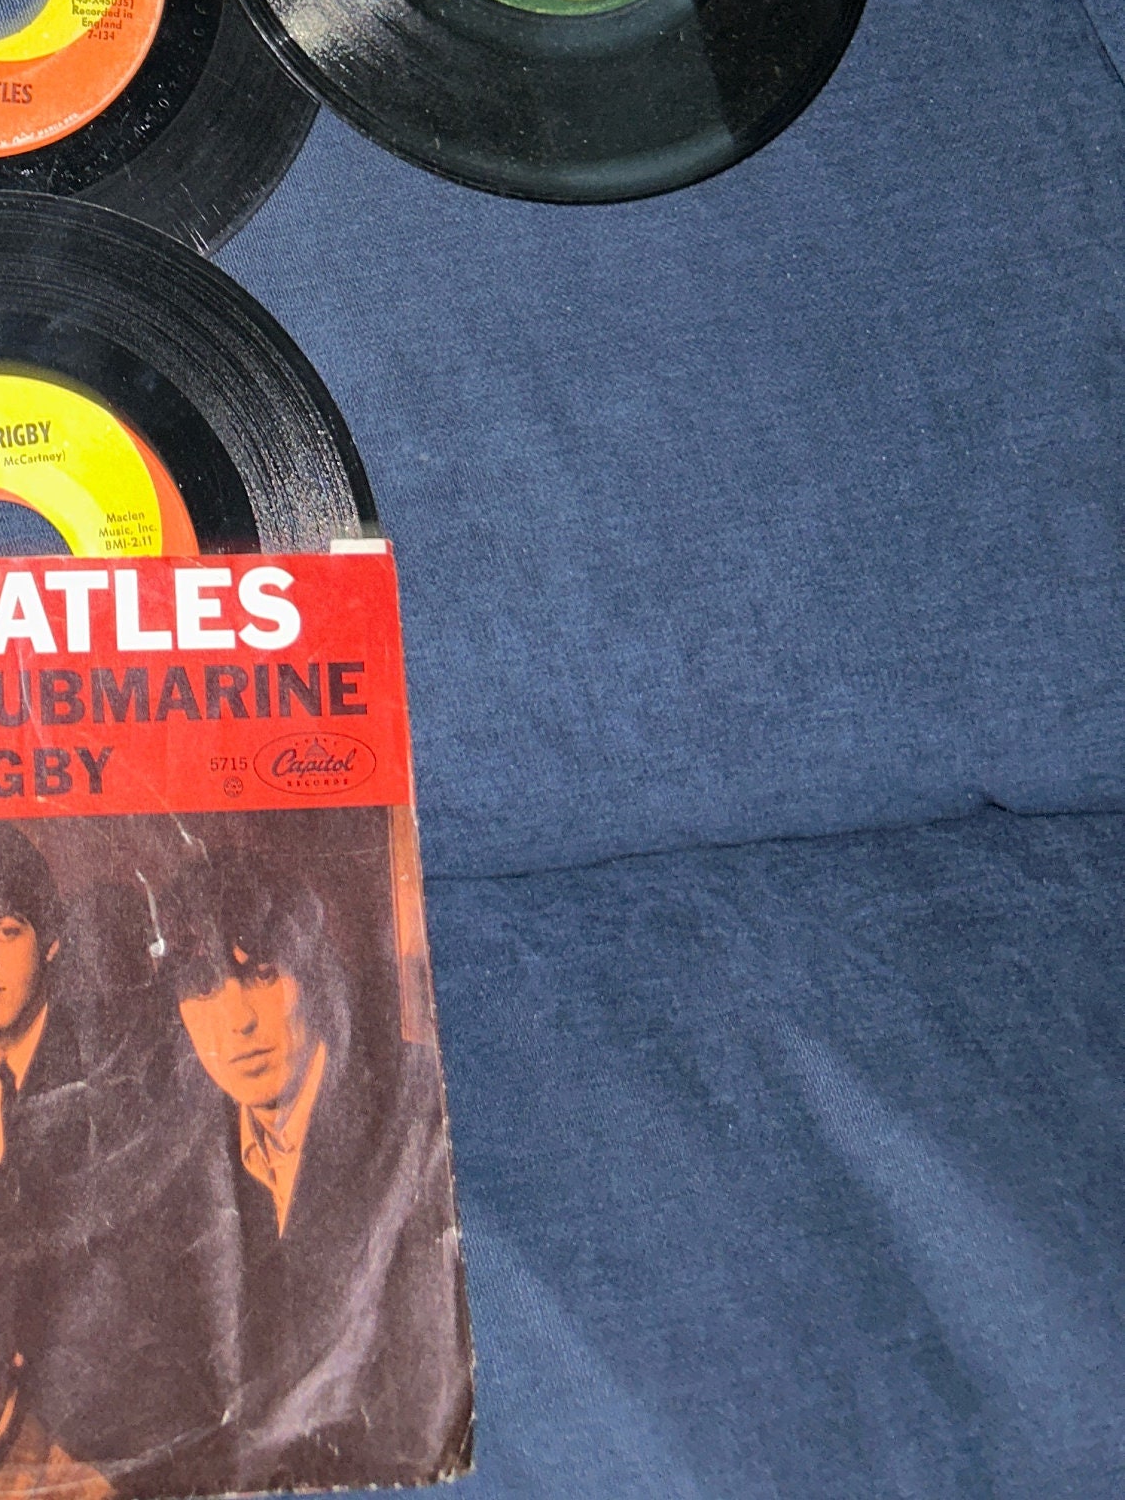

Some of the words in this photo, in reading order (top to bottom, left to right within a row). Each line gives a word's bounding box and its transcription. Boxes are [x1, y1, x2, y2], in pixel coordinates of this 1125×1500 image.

[72, 5, 121, 19] Recorded
[123, 8, 133, 20] in
[82, 17, 123, 30] England
[87, 29, 115, 41] 7-134
[3, 449, 67, 467] McCartney)
[106, 510, 145, 524] Maclen
[98, 524, 133, 538] Music,
[137, 522, 157, 534] Inc.
[210, 757, 248, 772] 5715
[271, 747, 357, 778] Capitol
[287, 778, 348, 787] RECORDS
